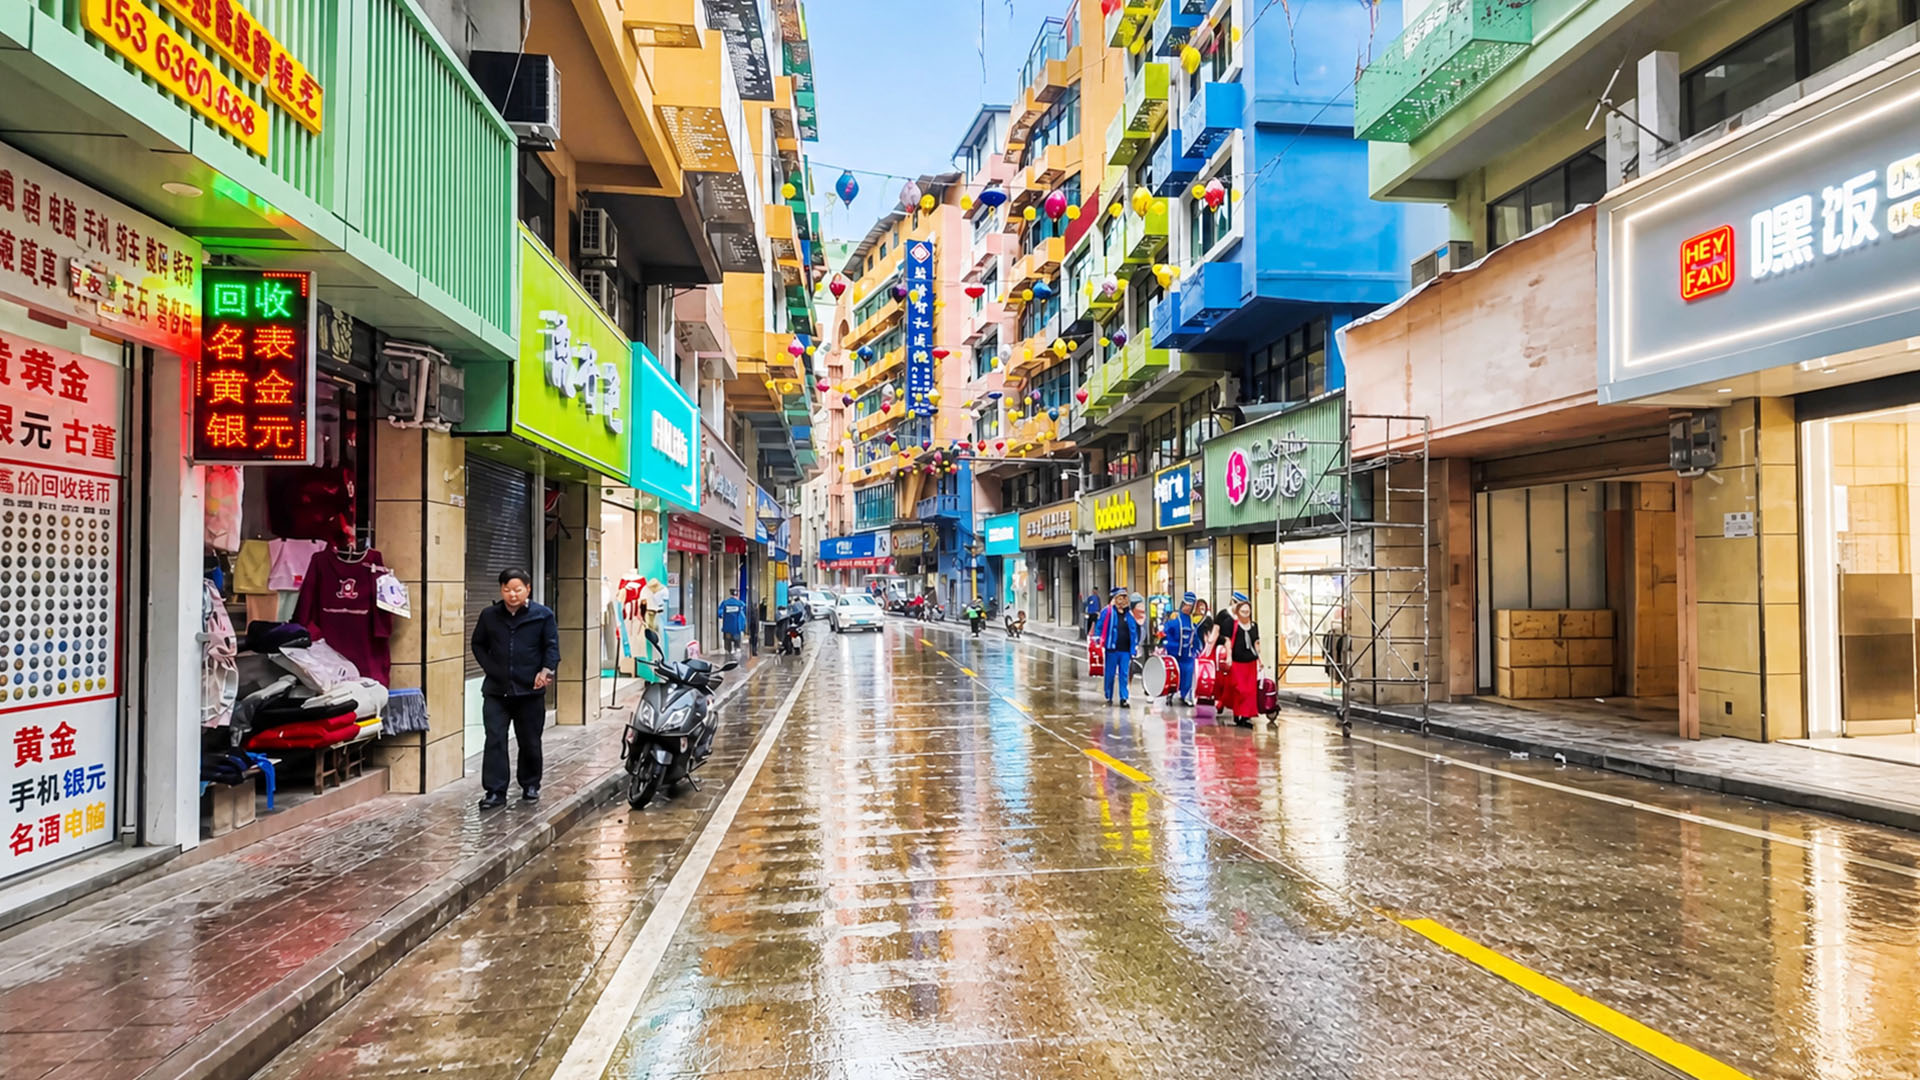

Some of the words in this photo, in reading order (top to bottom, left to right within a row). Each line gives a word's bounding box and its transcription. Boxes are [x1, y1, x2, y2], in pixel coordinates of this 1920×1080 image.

[1750, 170, 1879, 279] 嘿饭
[1687, 233, 1726, 264] HEY
[1687, 261, 1727, 293] FAN
[214, 281, 293, 318] 回收
[207, 323, 295, 360] 名表
[206, 369, 294, 404] 黄金
[63, 418, 117, 460] 古董
[206, 412, 294, 449] 银元
[13, 721, 77, 768] 黄金
[9, 773, 60, 813] 手机
[63, 763, 106, 798] 银元
[9, 813, 61, 857] 名酒
